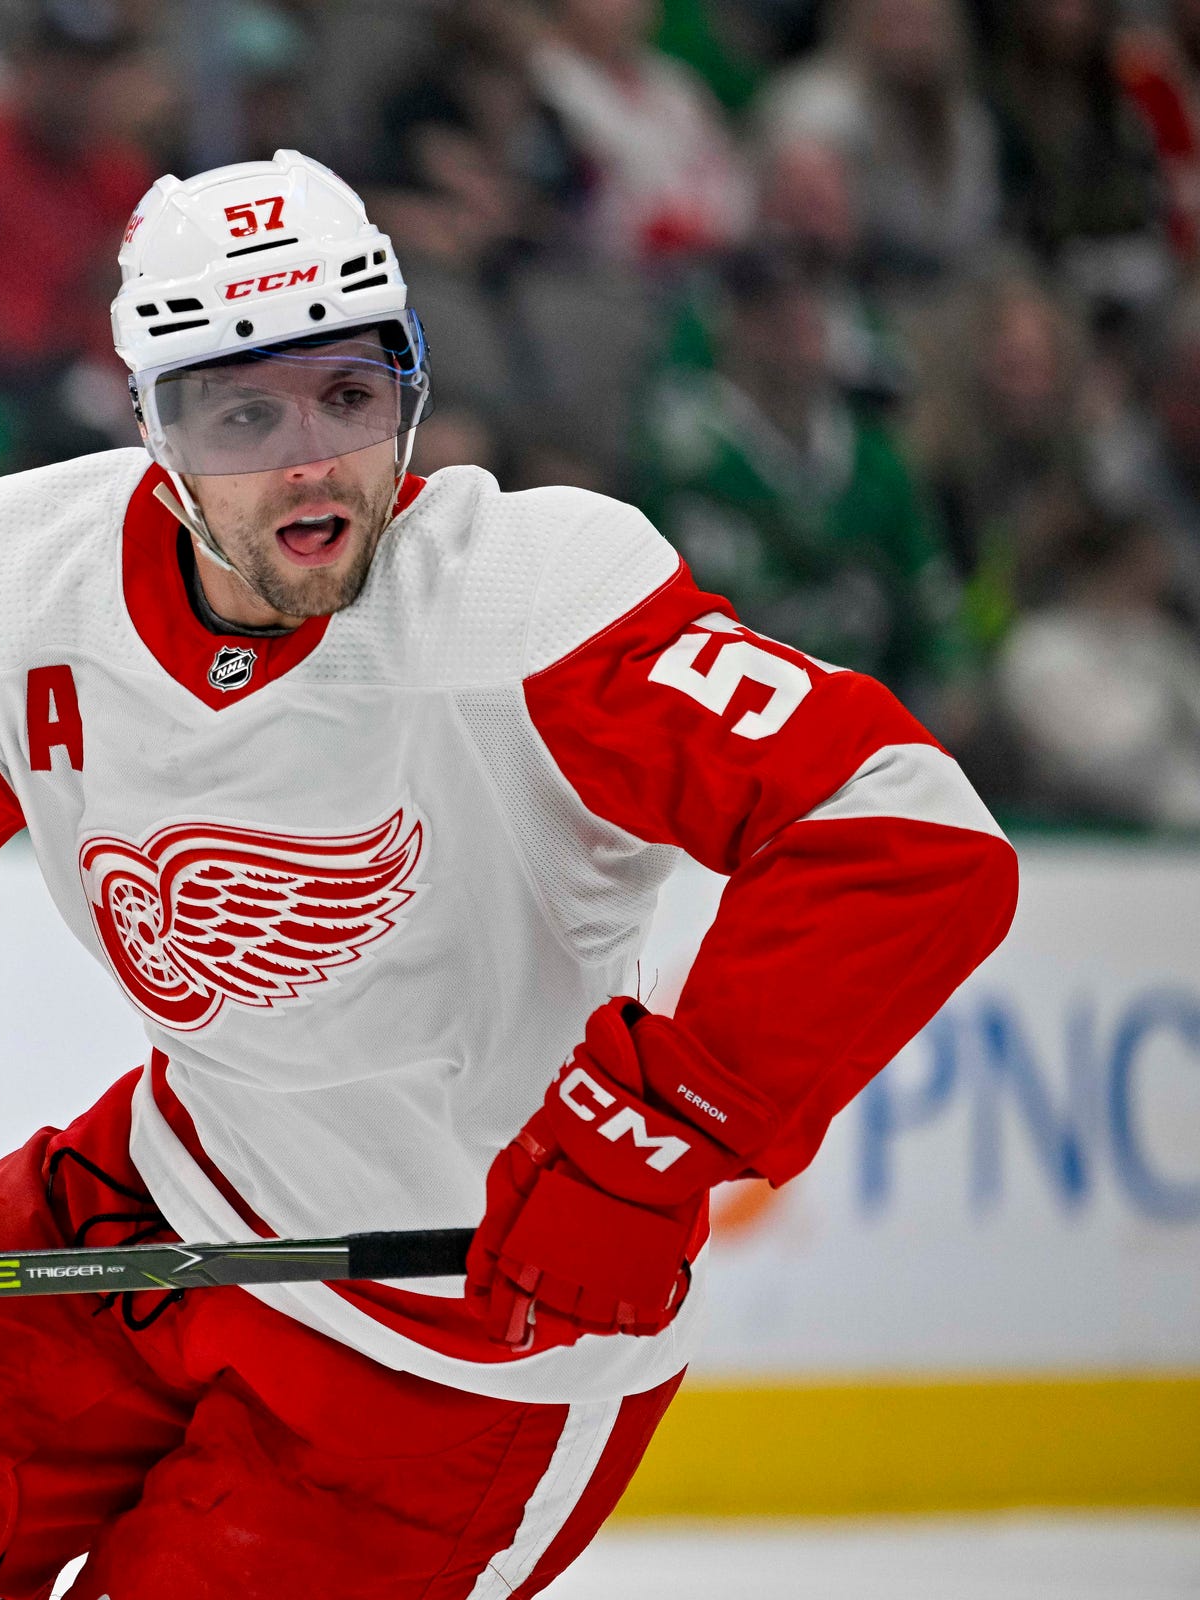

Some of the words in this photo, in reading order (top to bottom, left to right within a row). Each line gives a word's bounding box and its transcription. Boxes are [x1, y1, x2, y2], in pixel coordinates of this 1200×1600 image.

[223, 196, 285, 238] 57
[224, 265, 320, 301] CCM
[216, 658, 246, 680] NHL
[26, 664, 84, 772] A
[676, 1083, 728, 1124] PERRON
[852, 985, 1200, 1221] PNC
[25, 1264, 104, 1279] TRIGGER
